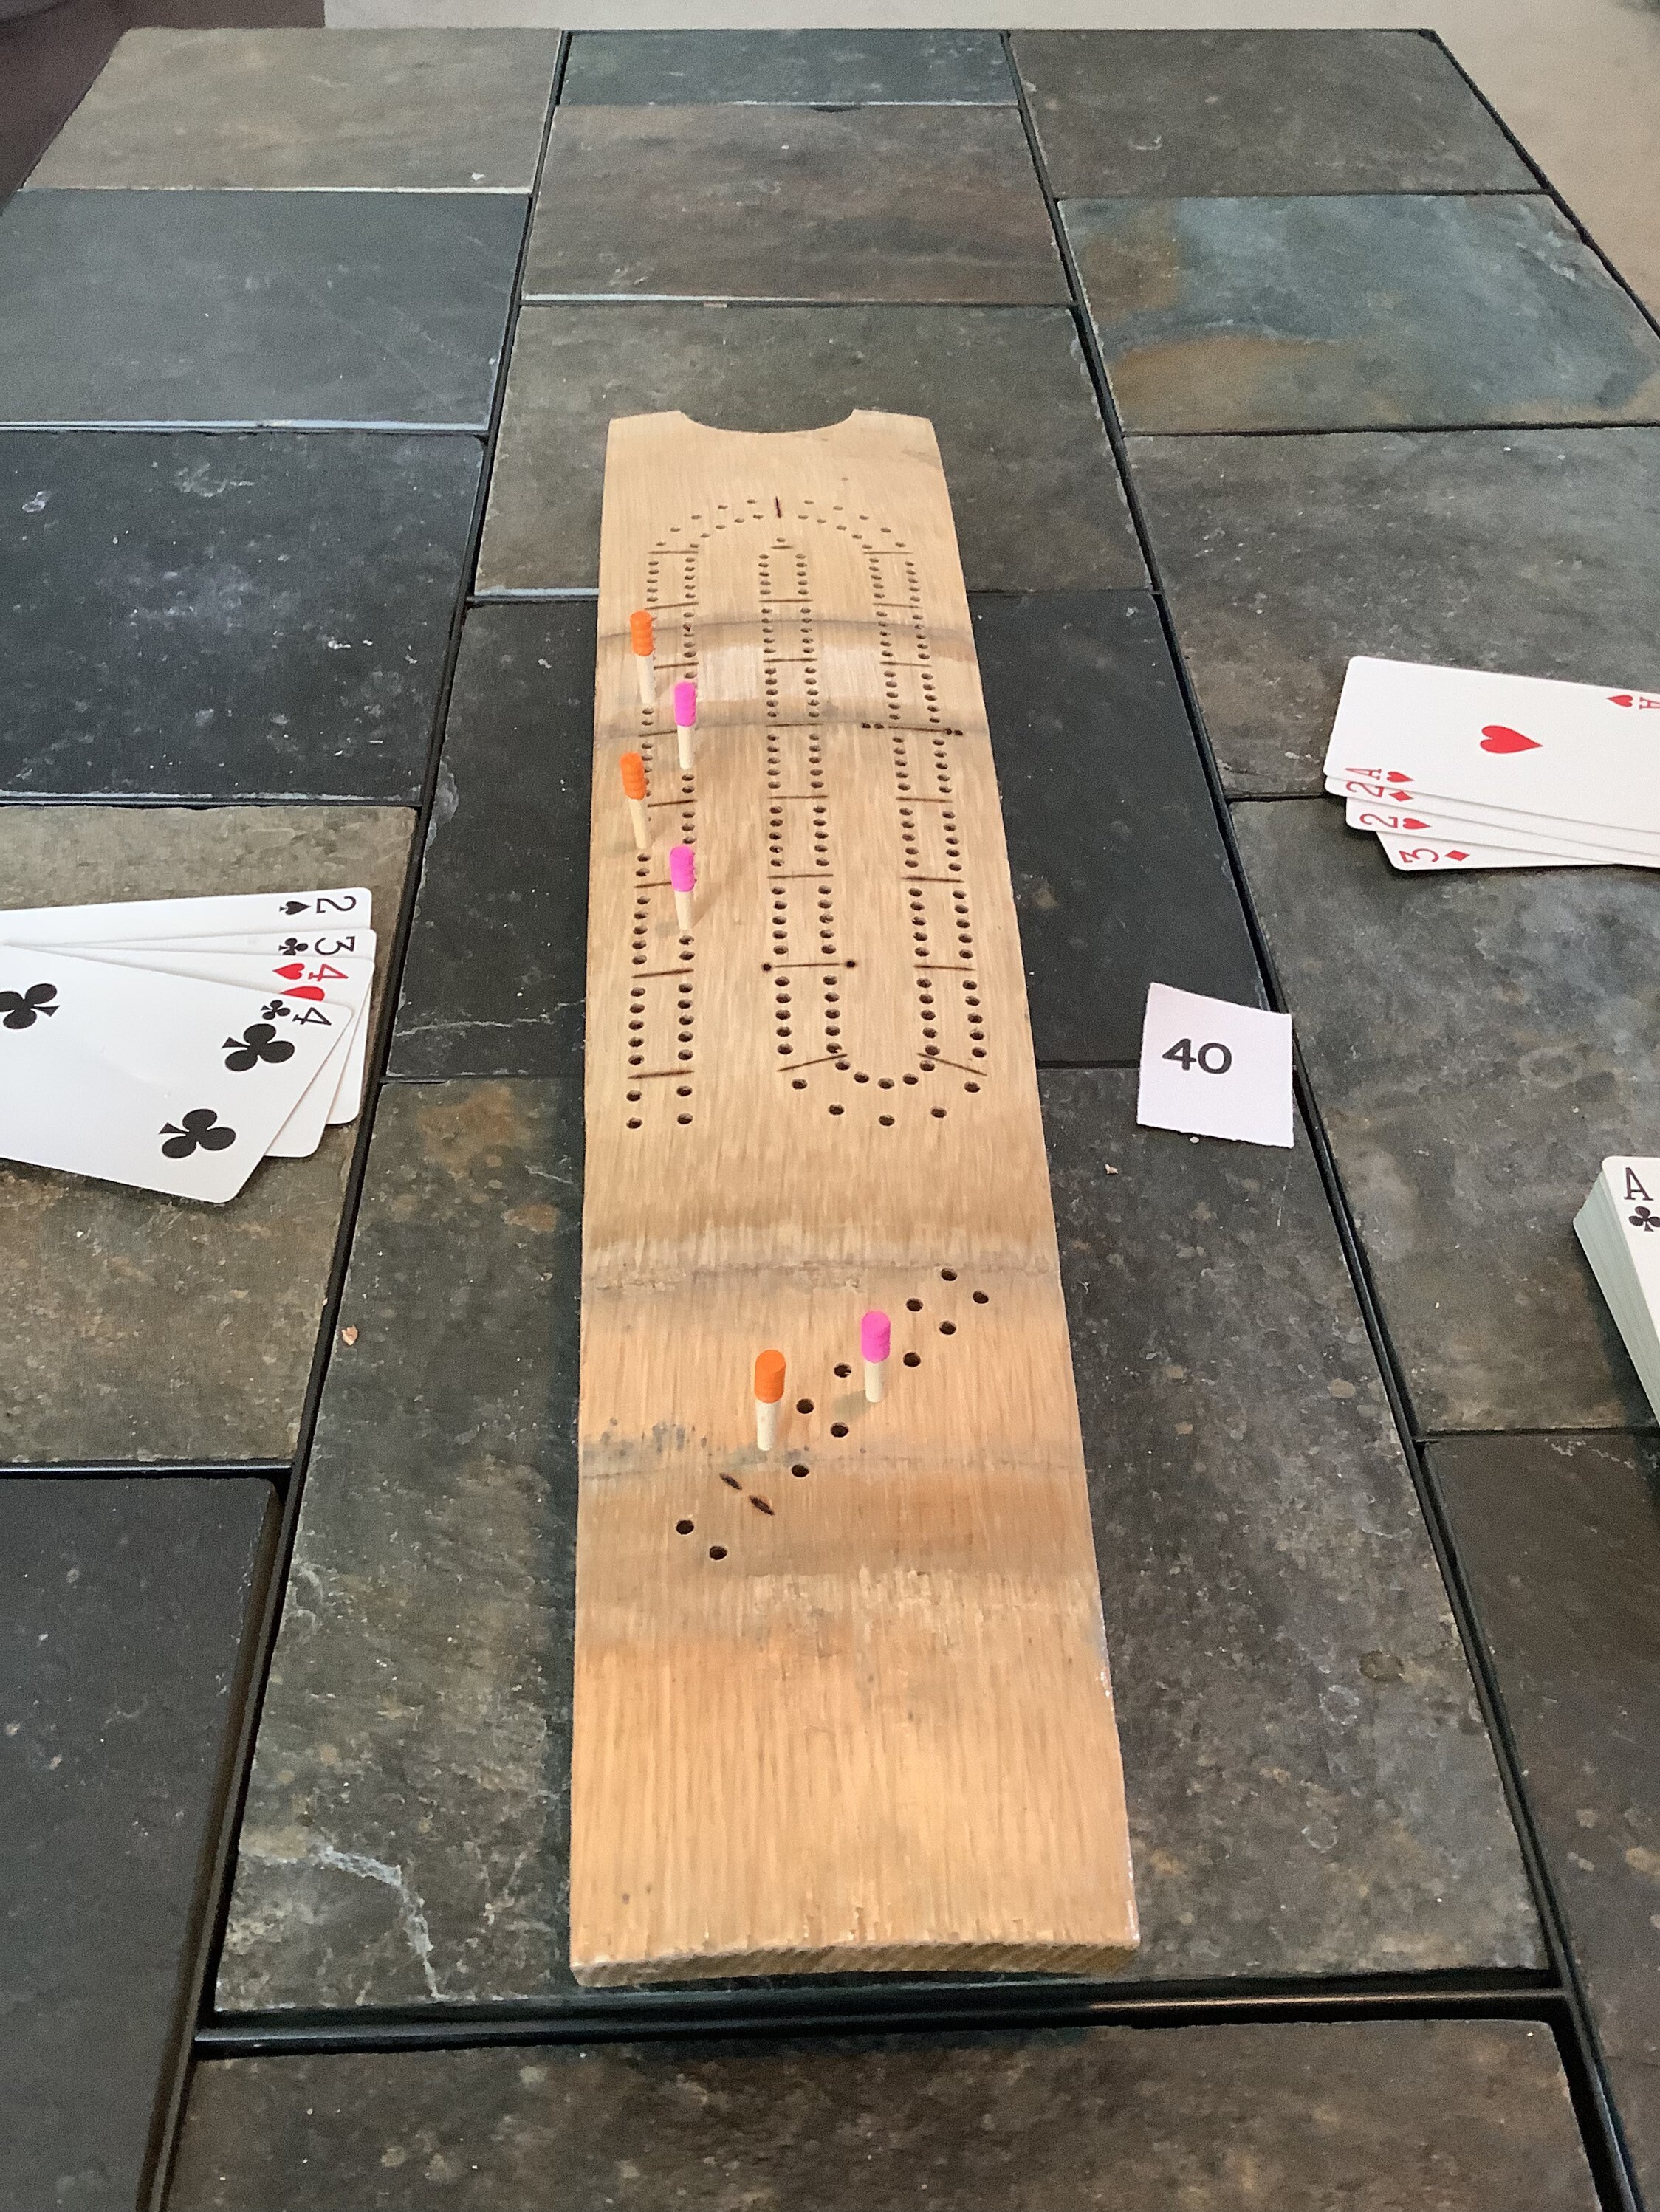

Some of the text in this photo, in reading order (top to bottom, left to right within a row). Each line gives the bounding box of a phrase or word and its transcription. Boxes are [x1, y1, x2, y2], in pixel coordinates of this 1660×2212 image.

[1345, 768, 1382, 780] A
[1345, 780, 1385, 798] 2
[1359, 813, 1398, 828] 2
[1399, 848, 1439, 863] 3
[316, 896, 357, 913] 2
[314, 936, 355, 955] 3
[308, 963, 349, 982] 4
[292, 1007, 332, 1026] 4
[1162, 1038, 1232, 1074] 40
[1624, 1167, 1654, 1201] A
